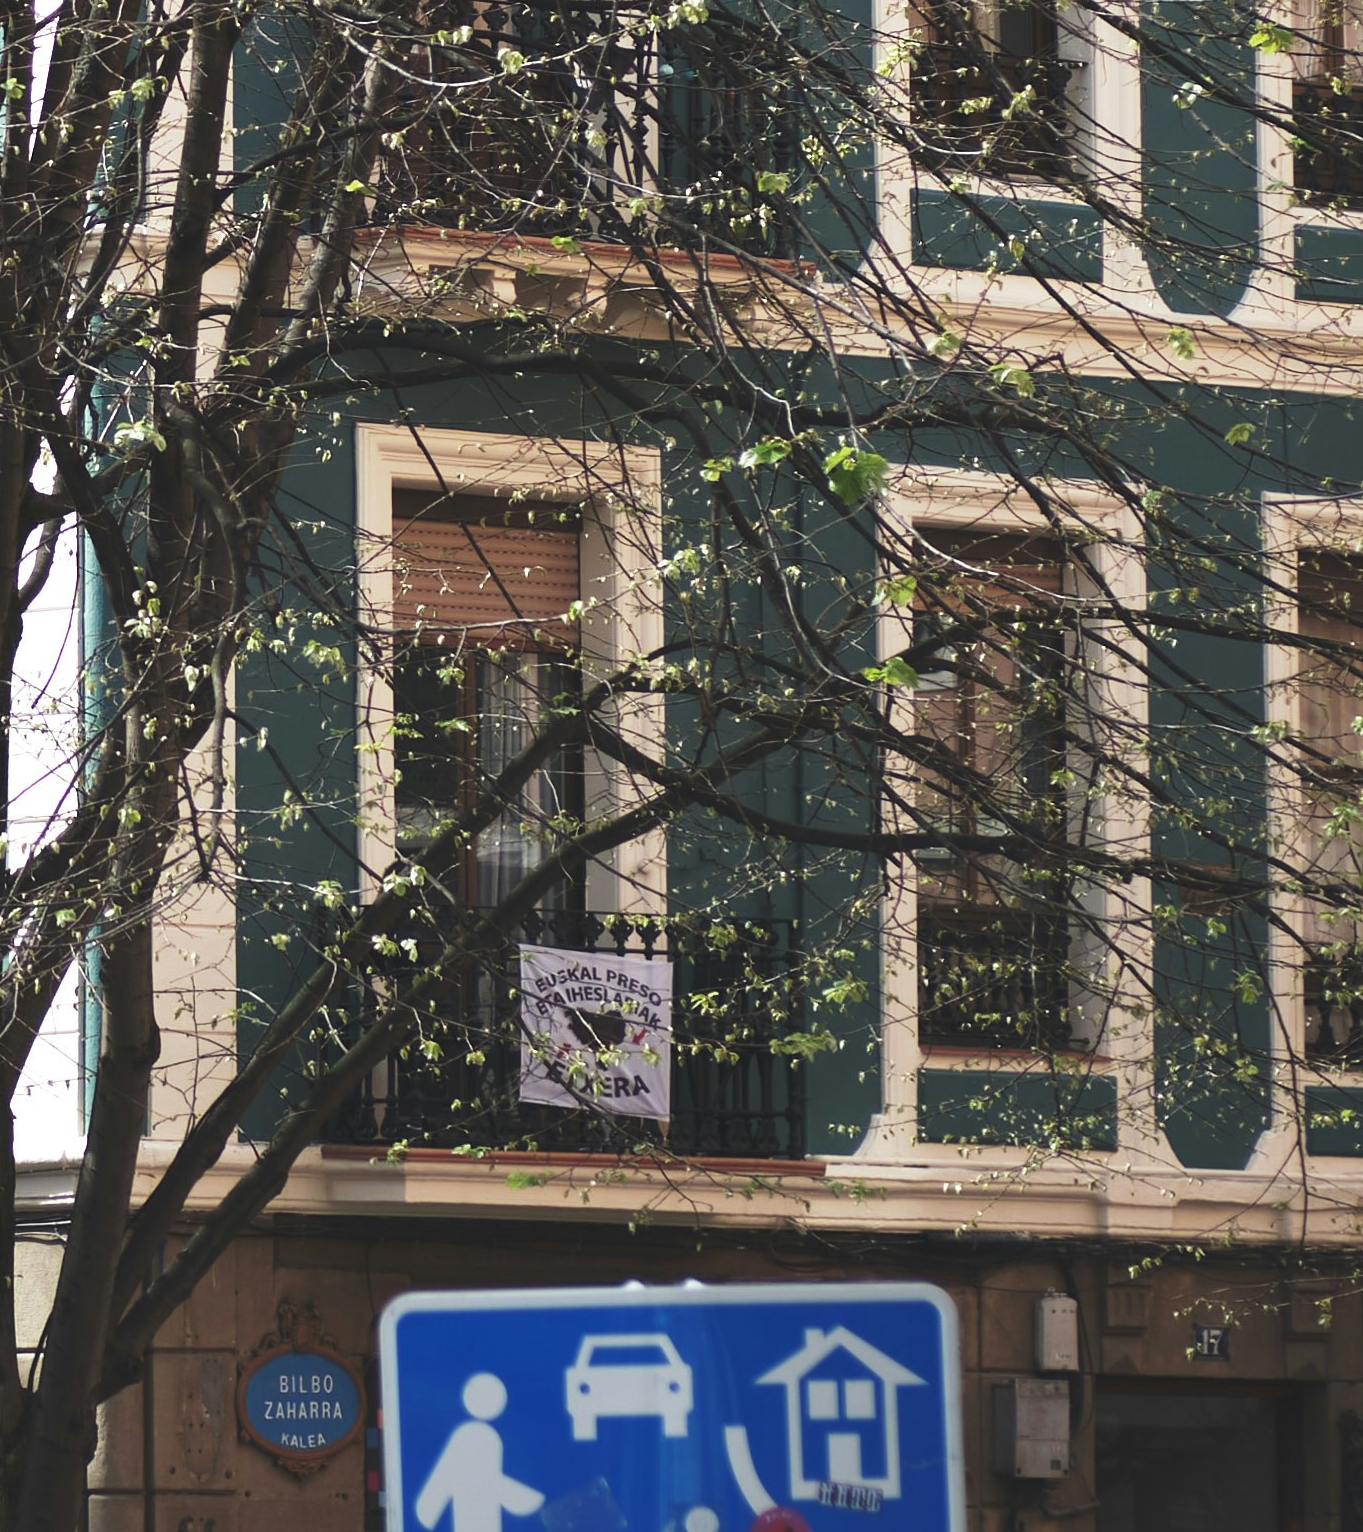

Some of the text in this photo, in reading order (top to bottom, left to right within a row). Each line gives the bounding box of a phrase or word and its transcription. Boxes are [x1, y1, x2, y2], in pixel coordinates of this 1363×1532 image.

[535, 967, 662, 1006] EUSKAL PRESO
[1201, 1328, 1224, 1355] 17
[280, 1375, 333, 1393] BILBO
[264, 1401, 342, 1419] ZAHARRA
[281, 1433, 326, 1448] KALEA
